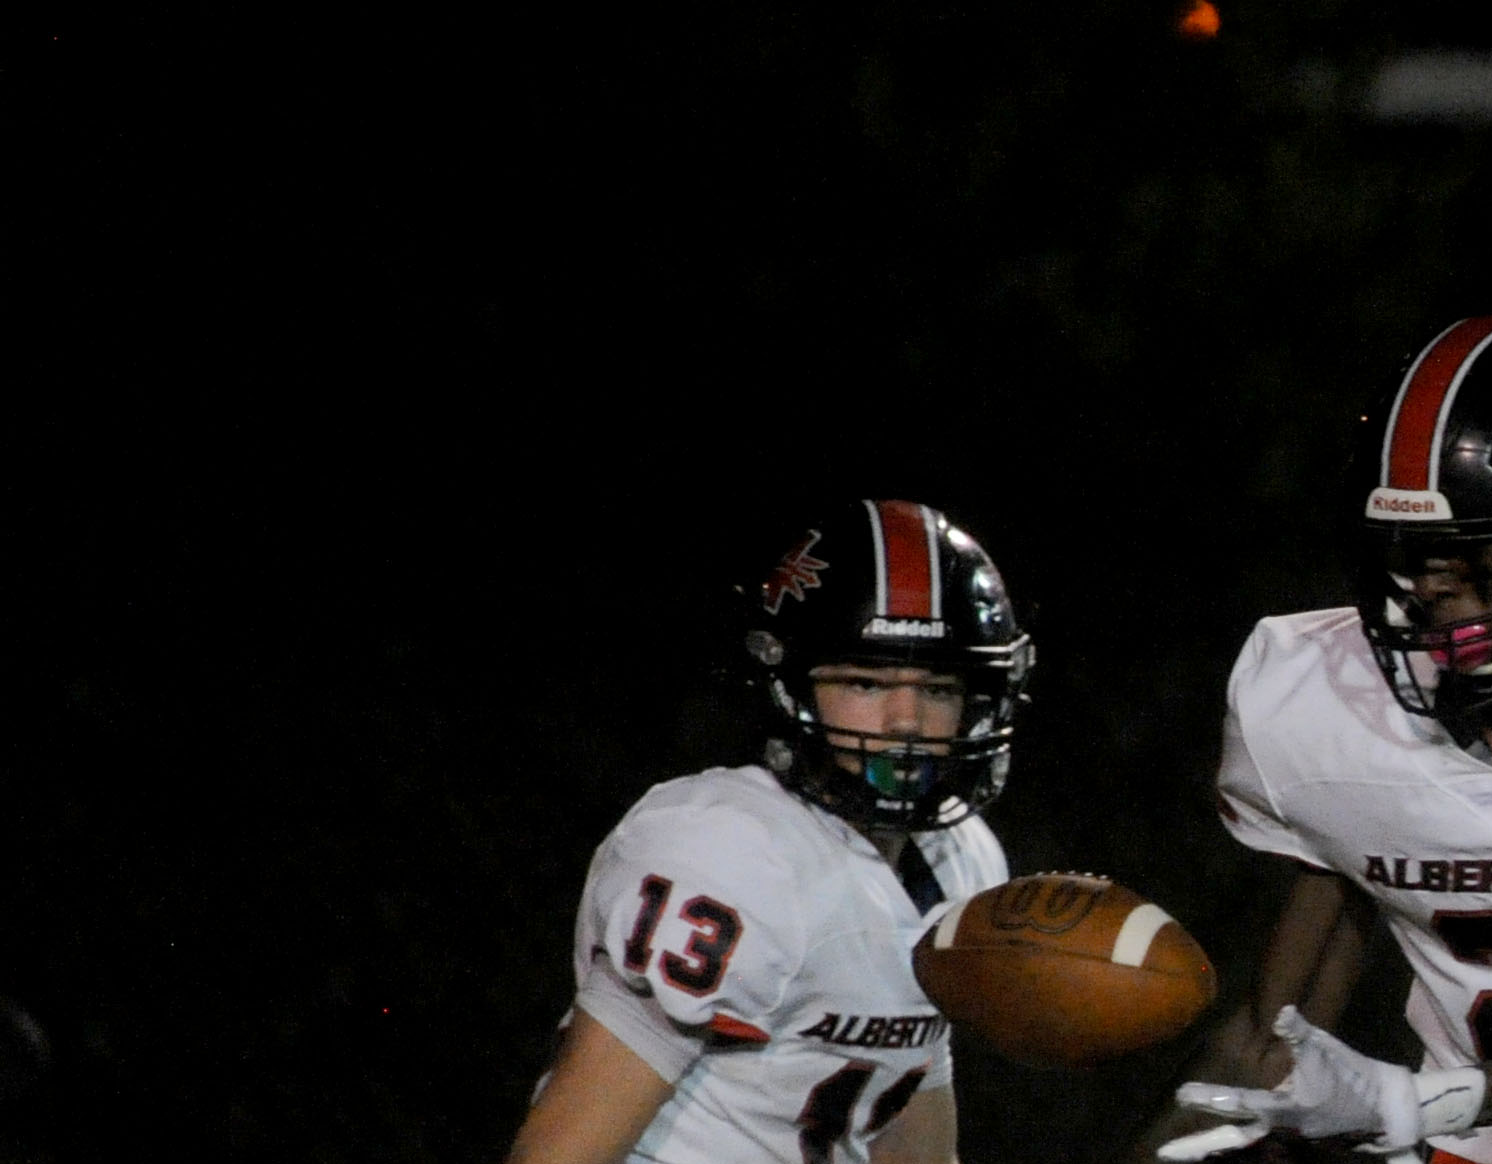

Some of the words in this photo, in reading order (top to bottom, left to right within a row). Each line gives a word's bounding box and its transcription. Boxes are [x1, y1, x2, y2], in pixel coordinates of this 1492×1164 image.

[1372, 496, 1436, 513] Riddell
[871, 618, 944, 638] Riddell
[623, 872, 744, 999] 13
